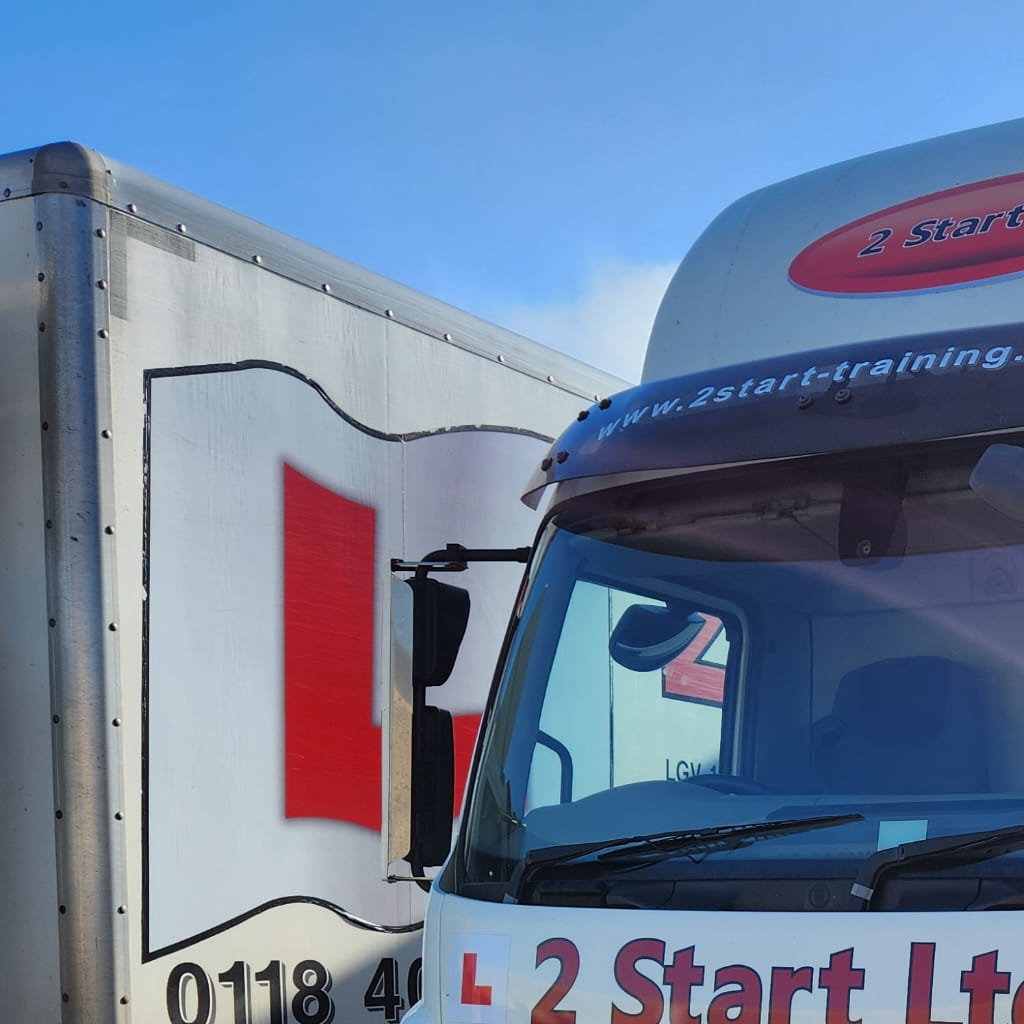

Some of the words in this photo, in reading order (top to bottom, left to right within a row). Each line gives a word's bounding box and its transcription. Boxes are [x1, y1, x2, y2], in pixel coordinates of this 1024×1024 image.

[857, 228, 893, 258] 2
[665, 758, 702, 781] LGV
[460, 952, 492, 1006] L
